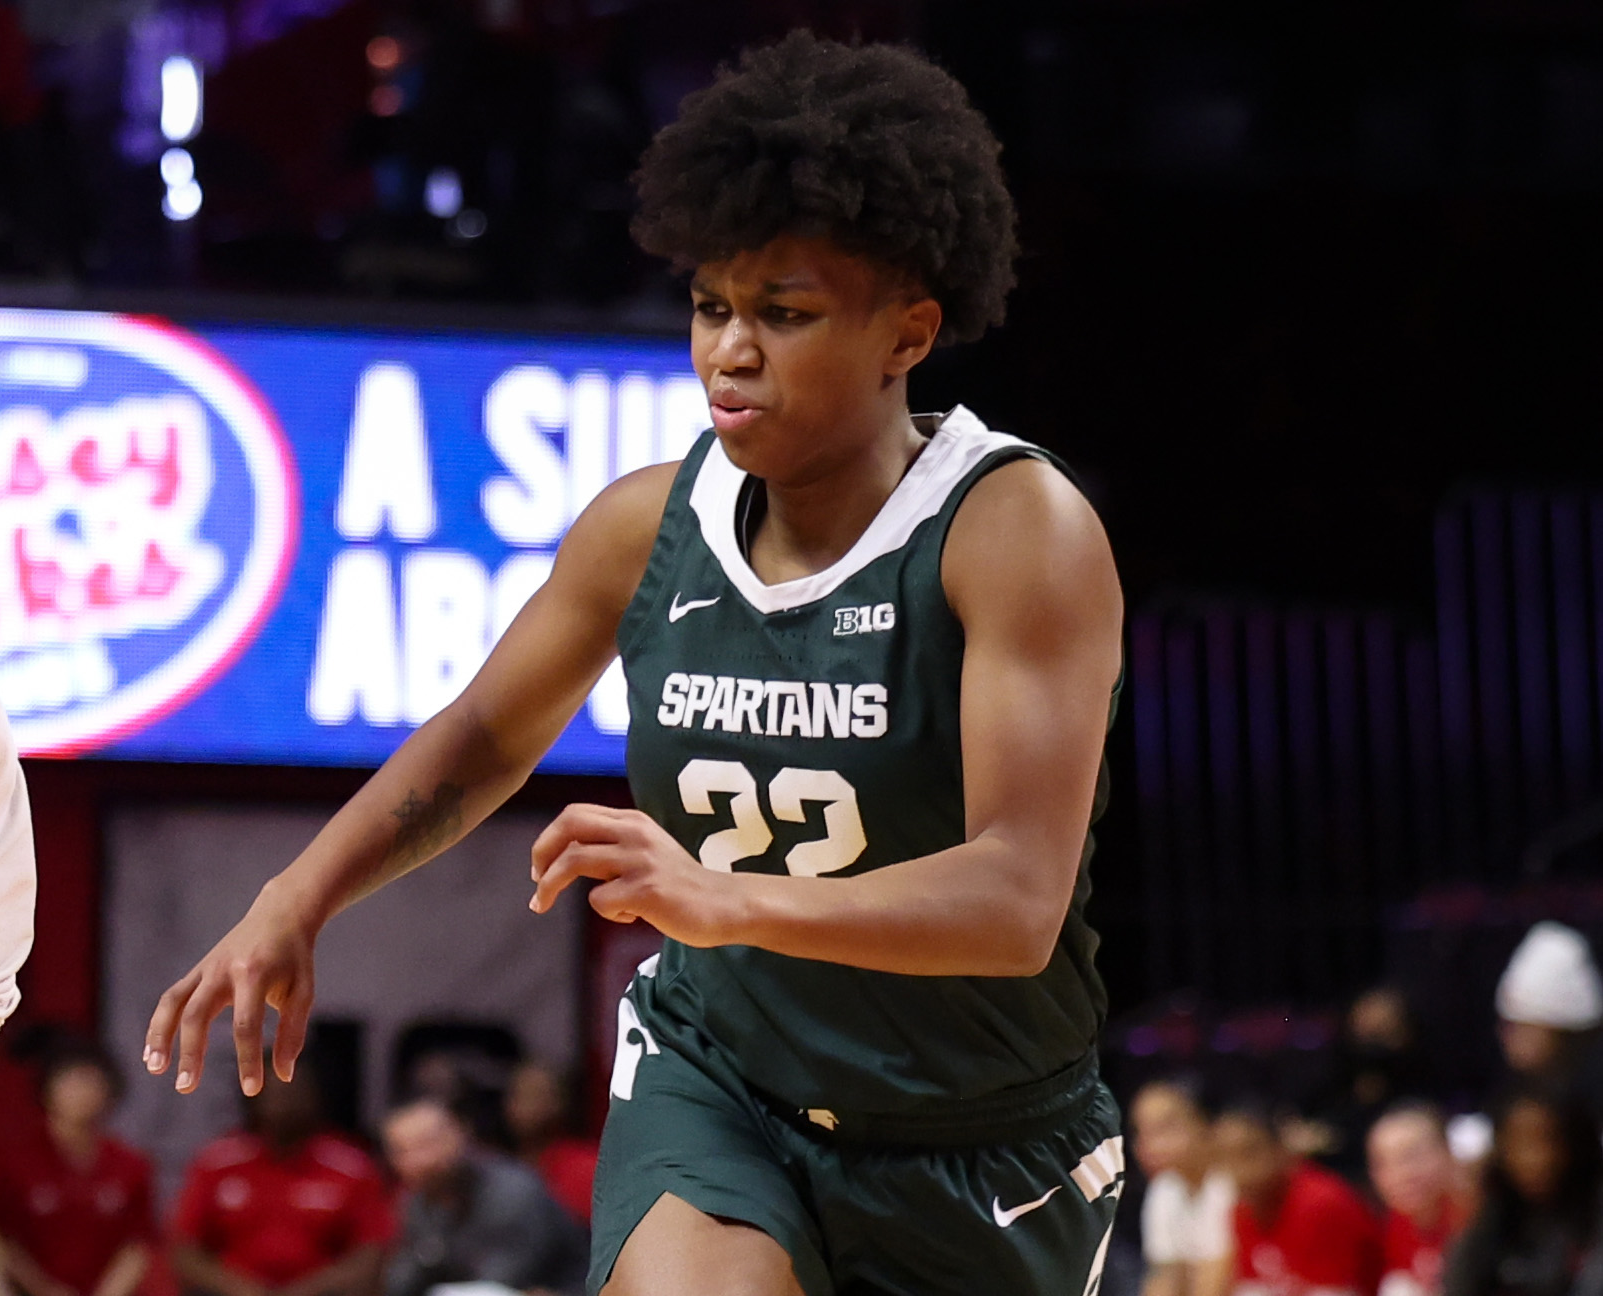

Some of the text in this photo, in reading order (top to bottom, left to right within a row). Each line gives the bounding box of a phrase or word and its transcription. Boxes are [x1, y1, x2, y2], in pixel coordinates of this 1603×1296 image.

[335, 362, 438, 543] A
[657, 673, 888, 738] SPARTANS
[677, 758, 868, 878] 22
